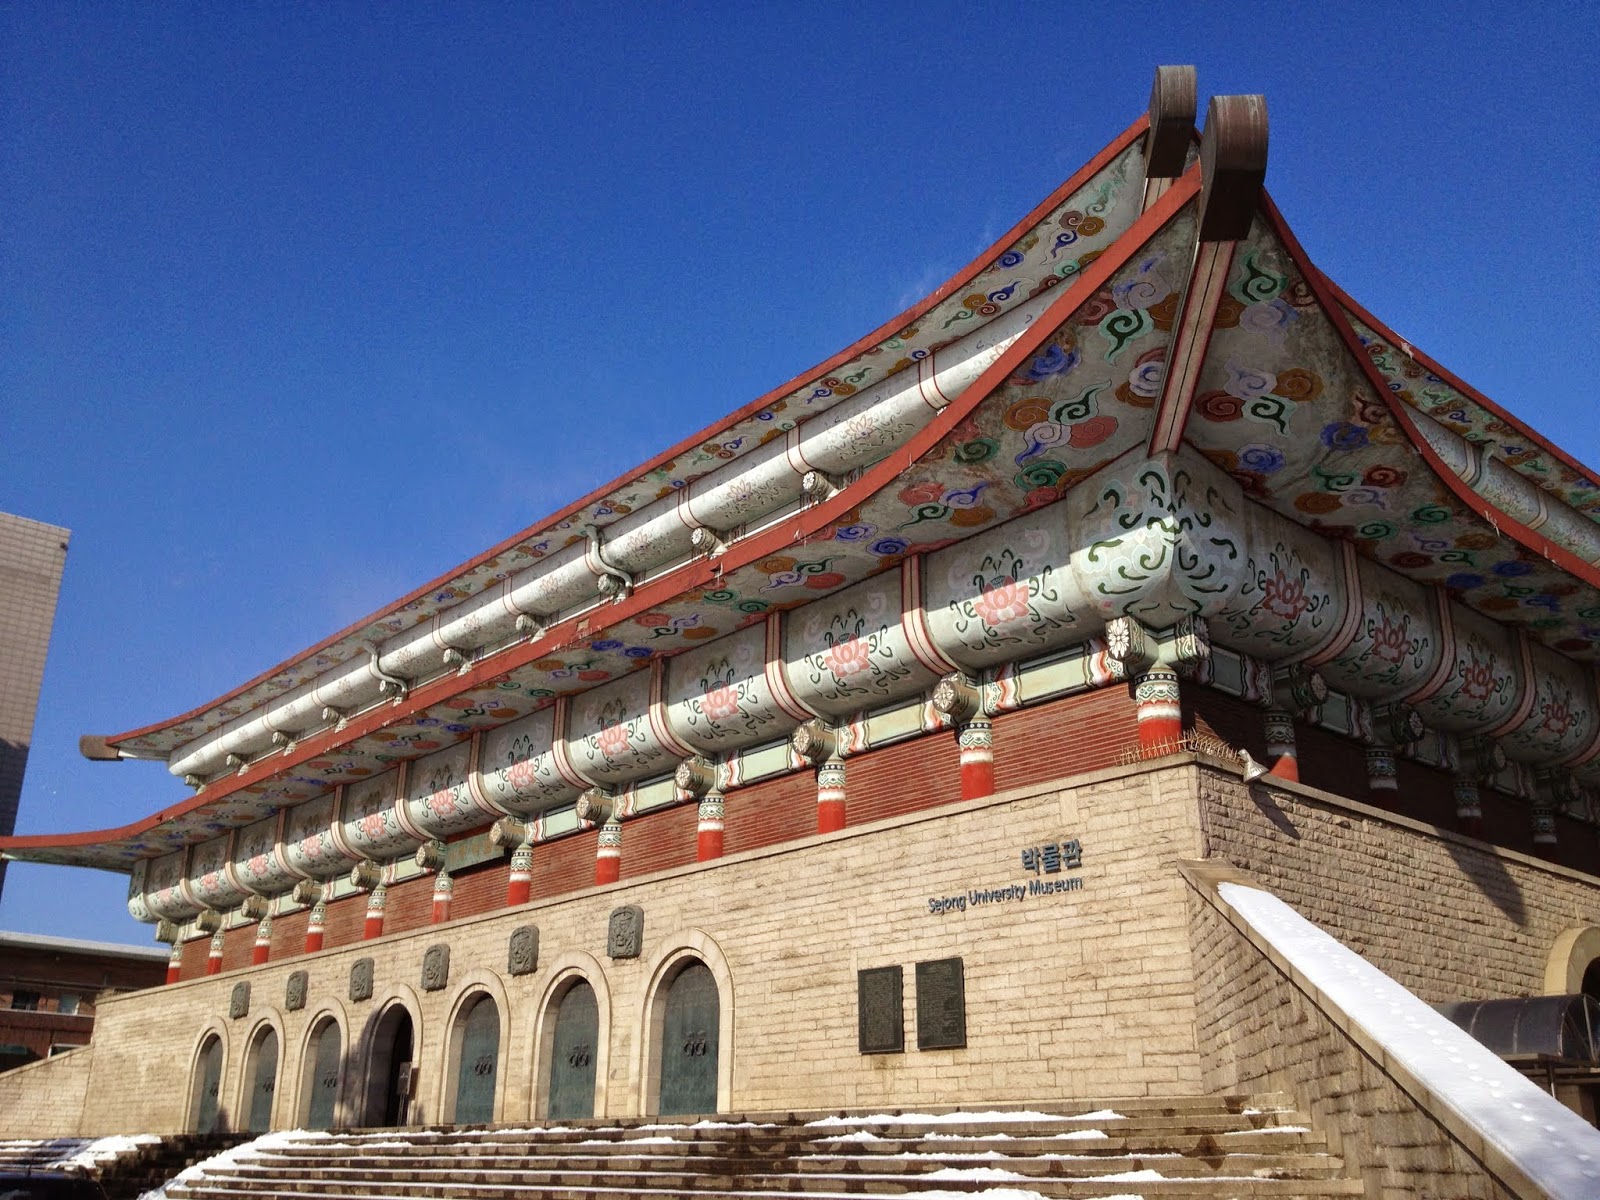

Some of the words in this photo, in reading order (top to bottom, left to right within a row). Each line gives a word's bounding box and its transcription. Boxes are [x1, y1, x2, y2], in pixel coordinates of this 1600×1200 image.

[1021, 839, 1083, 875] 박물관
[928, 895, 966, 915] Sejong
[968, 884, 1026, 906] University
[1029, 877, 1083, 896] Museum
